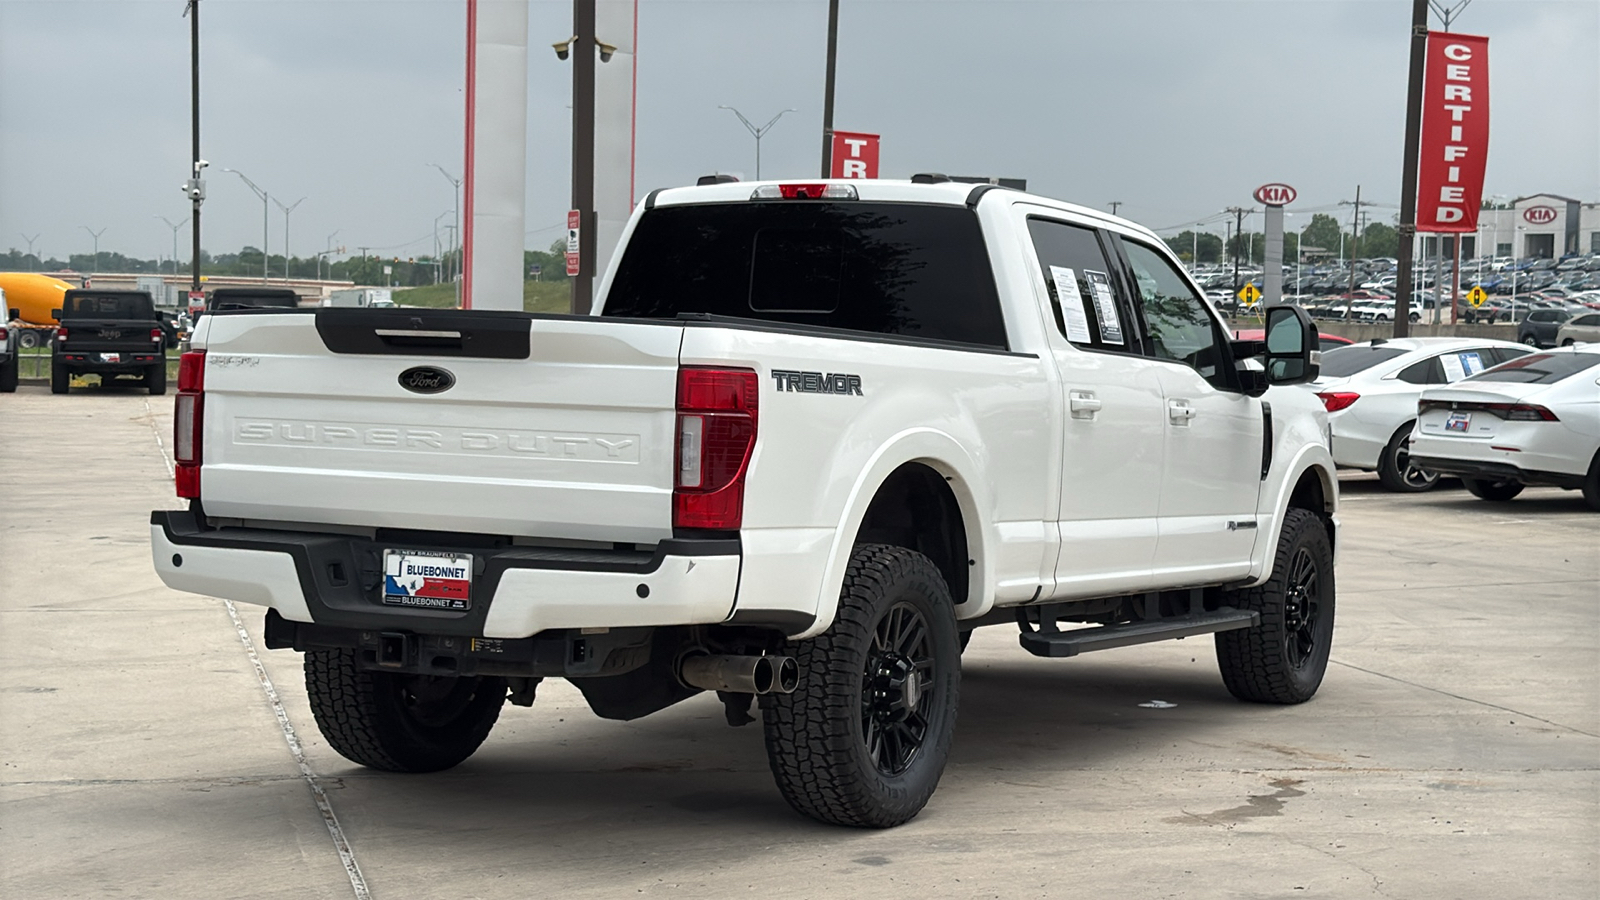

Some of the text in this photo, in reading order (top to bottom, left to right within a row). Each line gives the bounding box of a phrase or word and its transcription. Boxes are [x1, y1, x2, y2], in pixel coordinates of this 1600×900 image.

[1436, 44, 1472, 223] CERTIFIED
[1262, 187, 1290, 202] KIA
[1529, 209, 1551, 221] KIA
[98, 329, 121, 339] Jeep
[410, 371, 441, 387] Ford
[771, 369, 864, 397] TREMOR
[239, 422, 633, 458] SUPER DUTY
[407, 565, 465, 578] BLUEBONNET
[402, 596, 451, 607] BLUEBONNET
